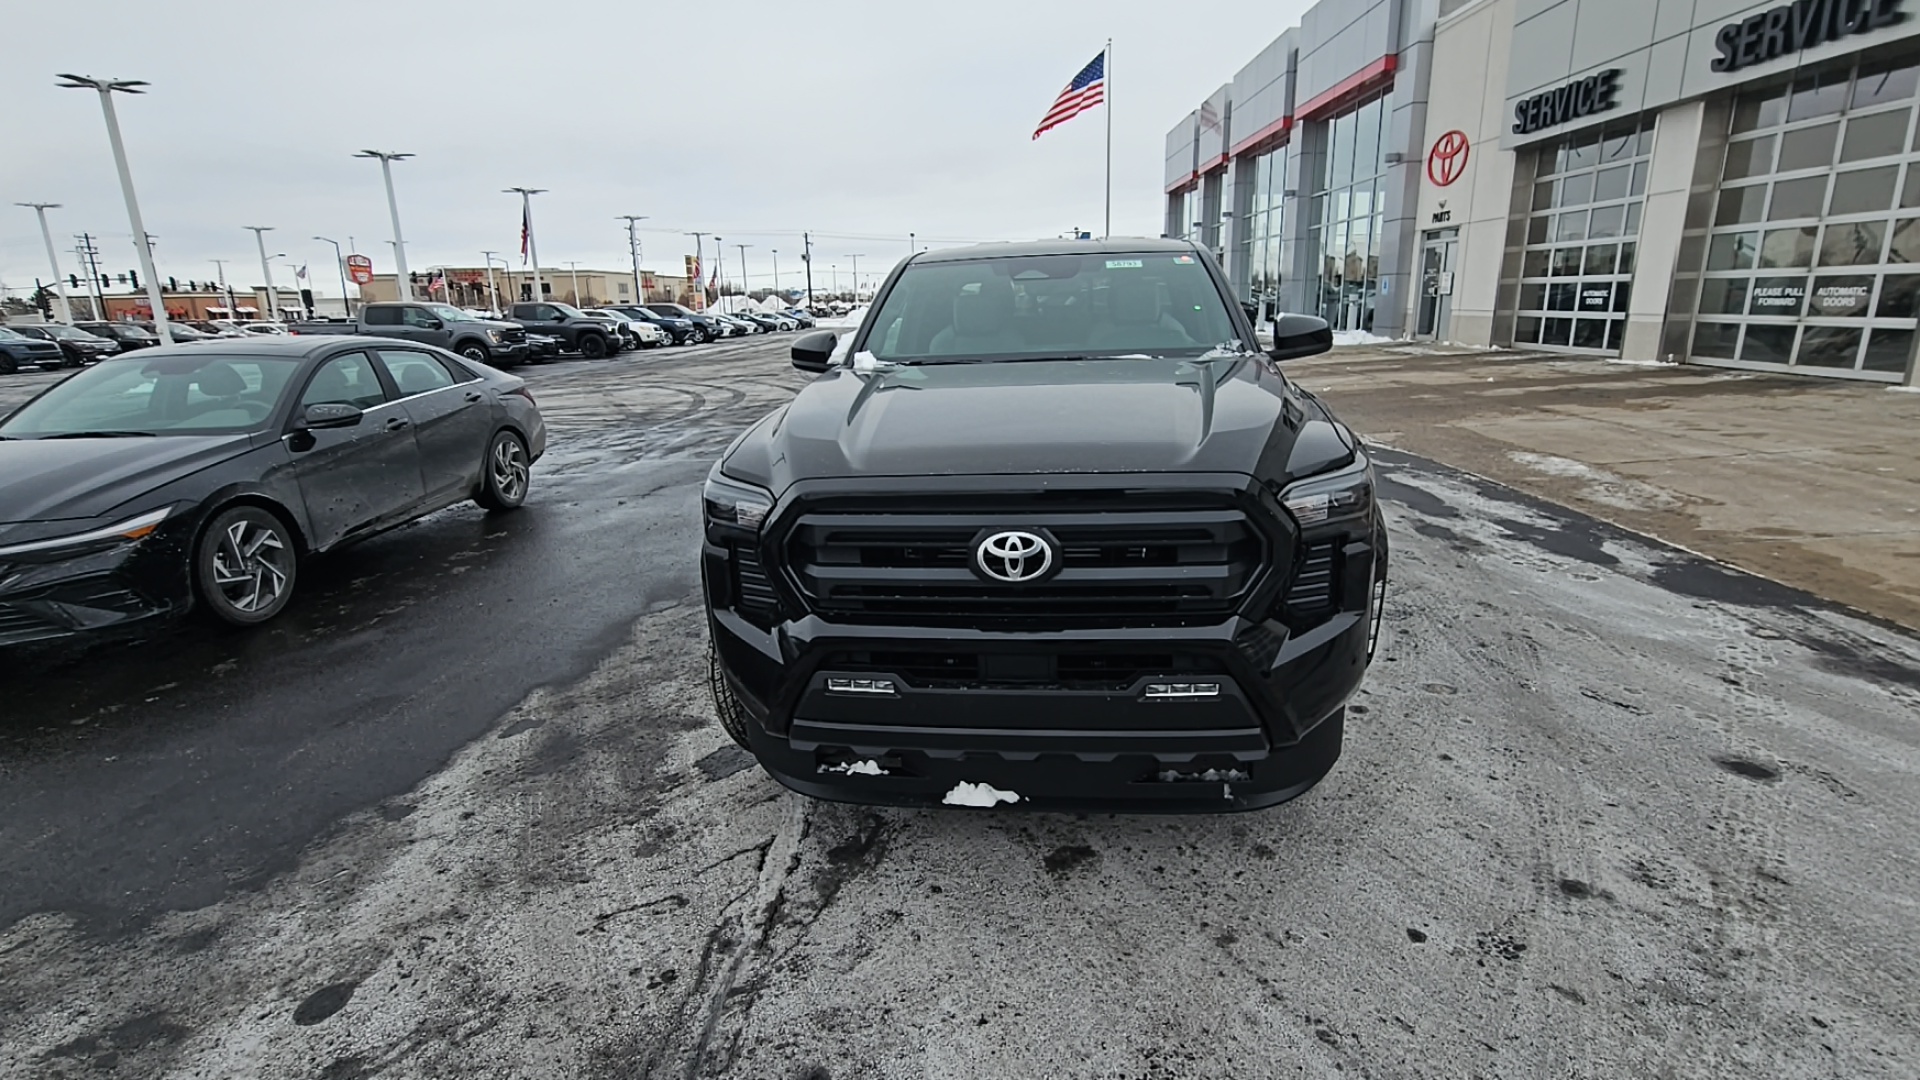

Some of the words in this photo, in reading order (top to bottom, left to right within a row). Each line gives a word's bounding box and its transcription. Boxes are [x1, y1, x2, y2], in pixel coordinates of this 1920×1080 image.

[1711, 0, 1906, 72] SERVICE
[1512, 68, 1620, 134] SERVICE
[1432, 210, 1451, 223] PARTS
[1754, 288, 1782, 296] PLEASE
[1784, 287, 1804, 296] PULL
[1817, 286, 1867, 296] AUTOMATIC
[1757, 297, 1797, 306] FORWARD
[1822, 297, 1856, 306] DOORS
